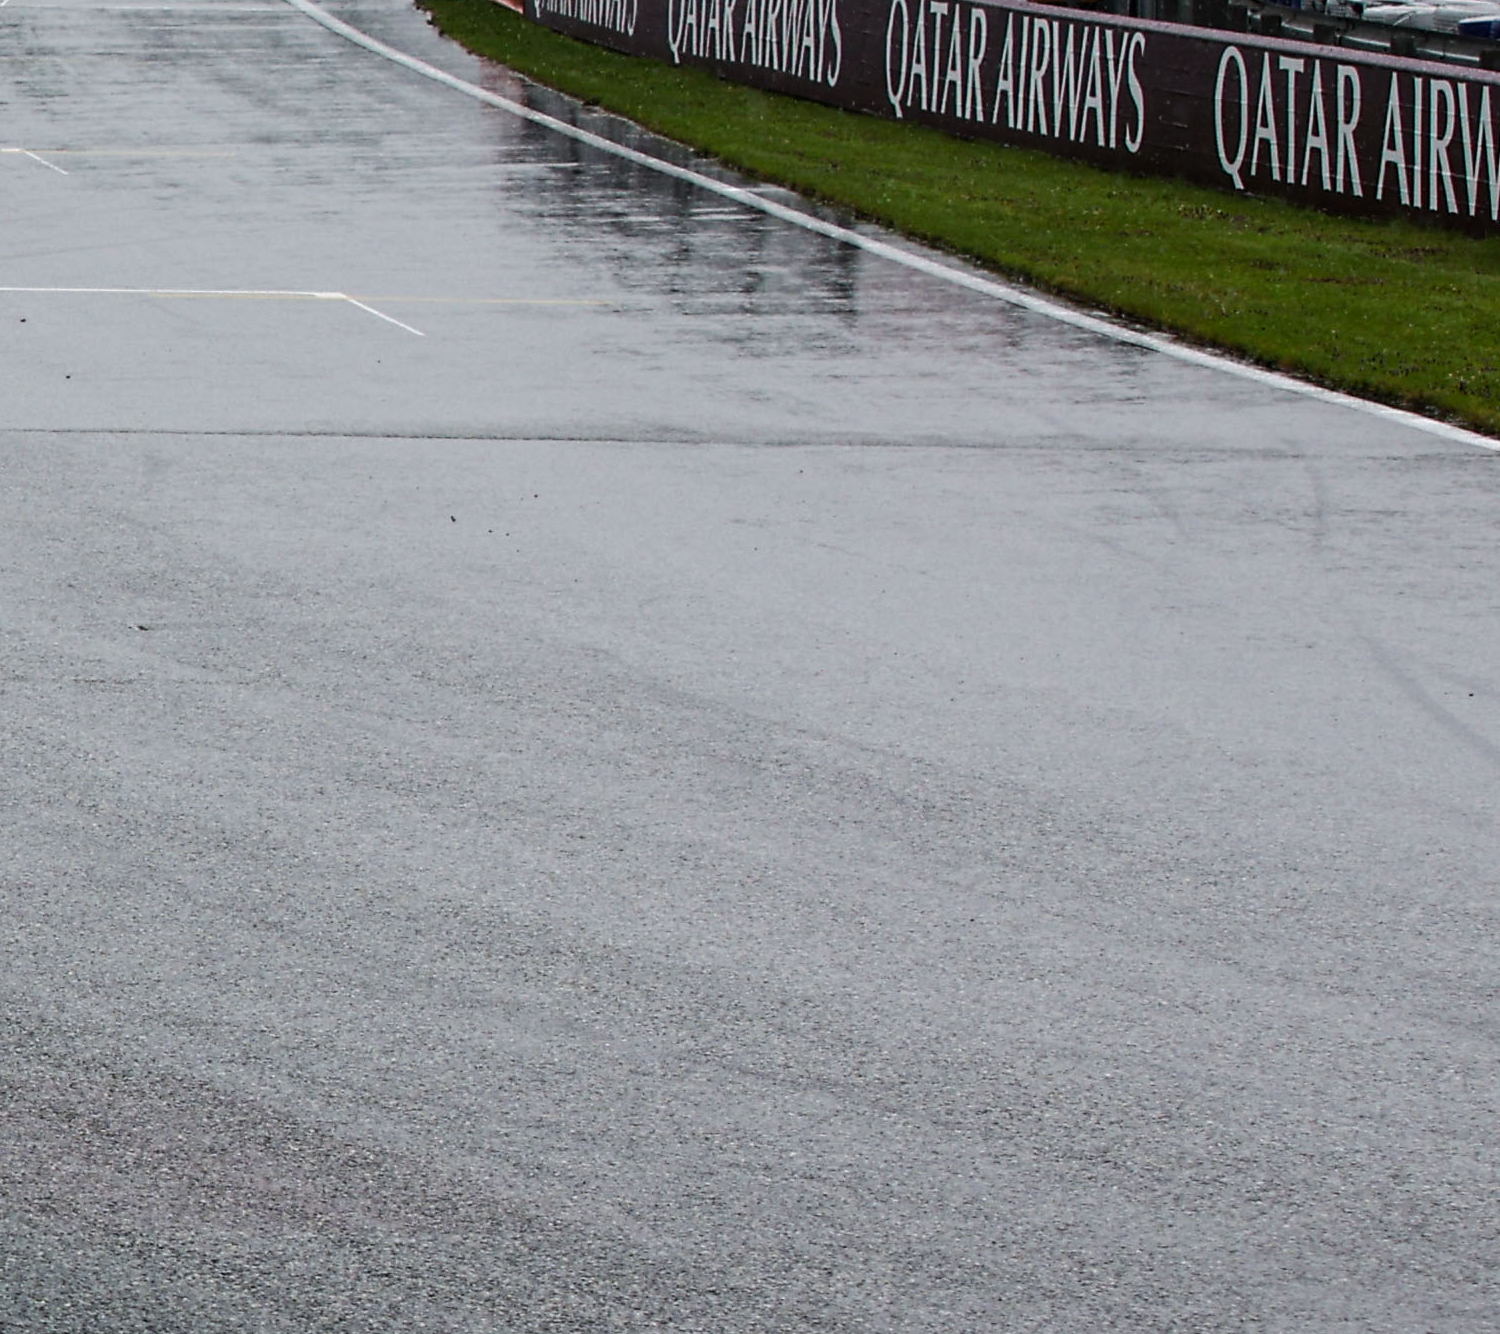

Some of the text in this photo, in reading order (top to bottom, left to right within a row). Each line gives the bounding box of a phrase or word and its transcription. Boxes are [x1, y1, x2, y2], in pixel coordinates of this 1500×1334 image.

[992, 11, 1146, 154] AIRWAYS
[1214, 45, 1500, 221] QATAR AIRW
